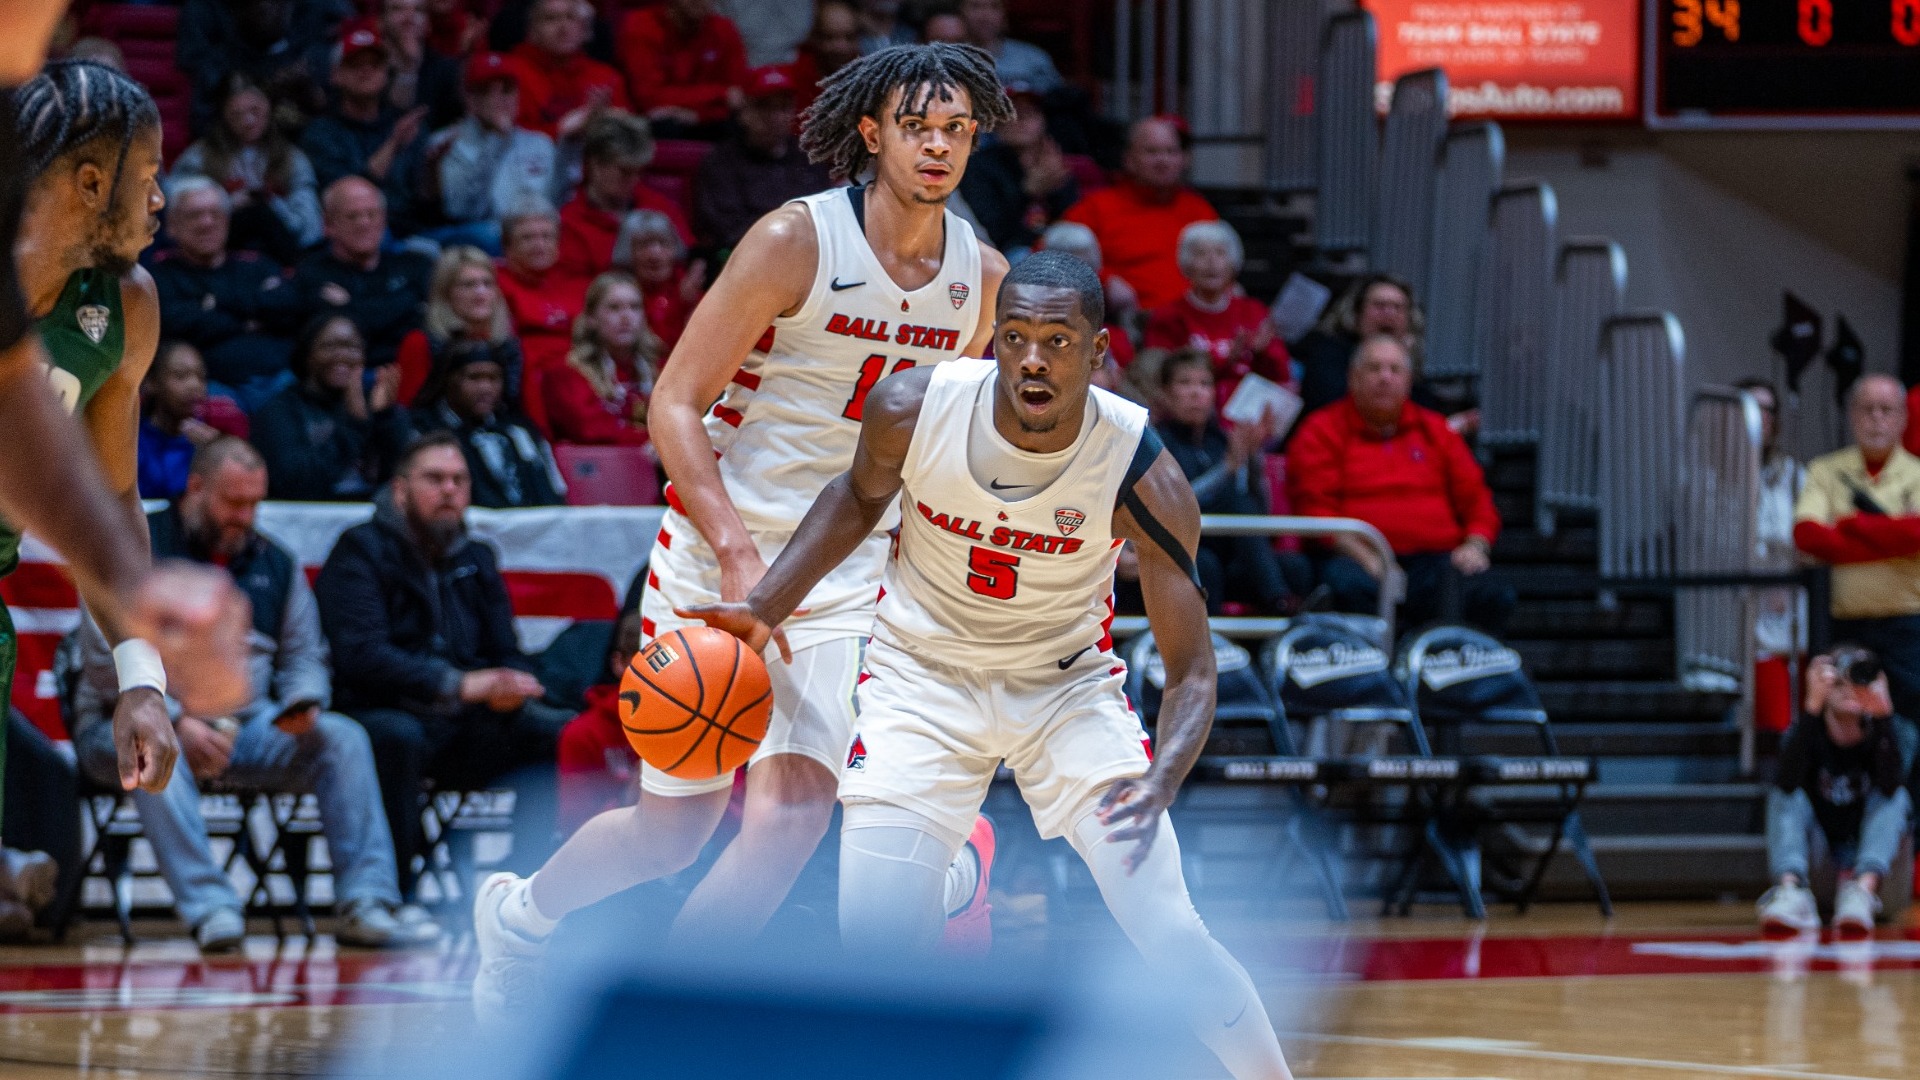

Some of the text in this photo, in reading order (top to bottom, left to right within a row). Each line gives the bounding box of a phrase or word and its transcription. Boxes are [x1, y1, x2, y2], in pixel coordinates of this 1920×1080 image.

[1398, 22, 1601, 44] TEAM BALL STATE
[1673, 0, 1740, 46] 34
[1798, 0, 1832, 46] 0
[825, 313, 960, 351] BALL STATE
[842, 353, 916, 422] 1
[990, 526, 1084, 555] STATE
[1056, 515, 1082, 527] MAC
[966, 545, 1020, 600] 5
